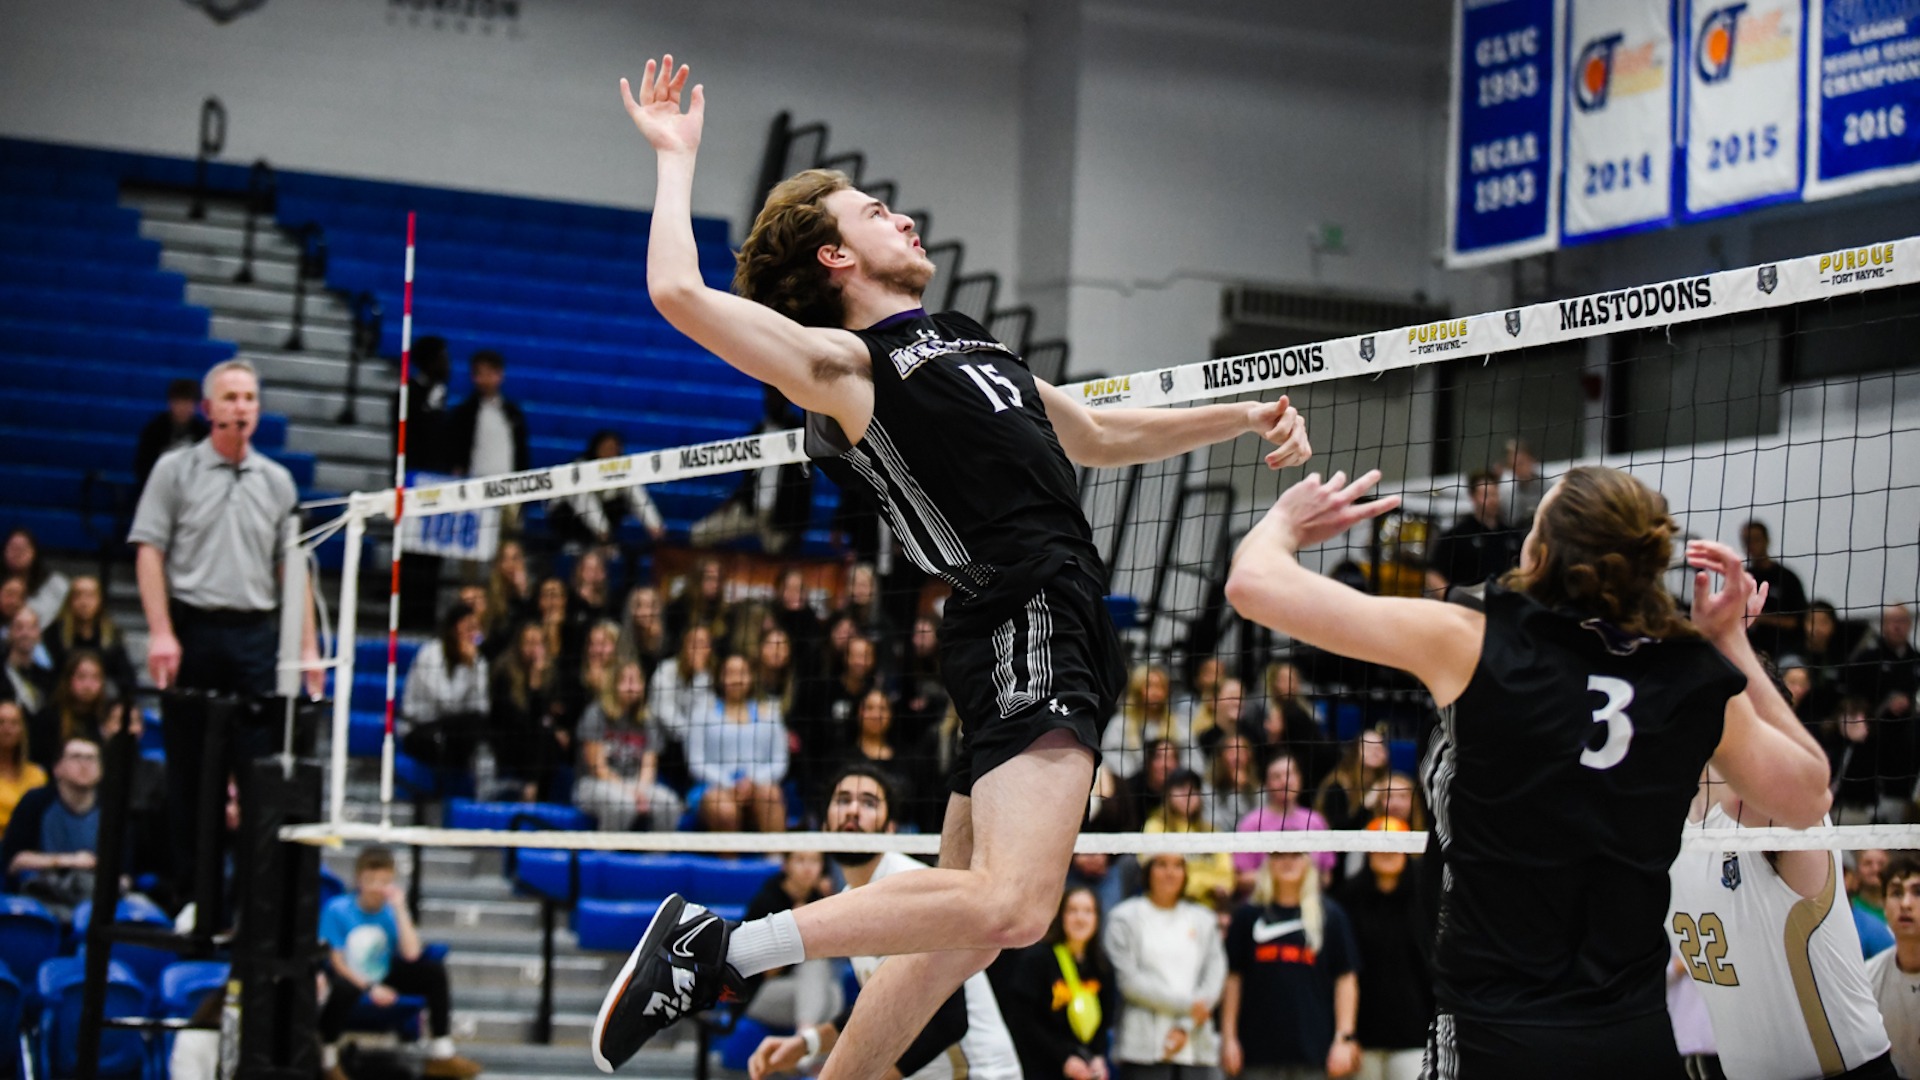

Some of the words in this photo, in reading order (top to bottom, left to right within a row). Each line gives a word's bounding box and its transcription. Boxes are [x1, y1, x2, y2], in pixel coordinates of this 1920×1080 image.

[1478, 63, 1539, 107] 1993
[1843, 103, 1906, 146] 2016
[1471, 132, 1539, 174] NCAA
[1708, 124, 1778, 171] 2015
[1475, 168, 1537, 214] 1993
[1584, 152, 1651, 195] 2014
[1819, 243, 1895, 274] PURDUE
[1832, 273, 1853, 285] FORT
[1855, 267, 1884, 281] WAYNE
[1559, 278, 1712, 330] MASTODONS
[1408, 319, 1468, 345] PURDUE
[1418, 345, 1434, 355] FORT
[1436, 340, 1461, 351] WAYNE
[958, 363, 1023, 413] 15
[1203, 346, 1324, 390] MASTODONS
[1579, 675, 1635, 769] 3
[1673, 912, 1740, 987] 22
